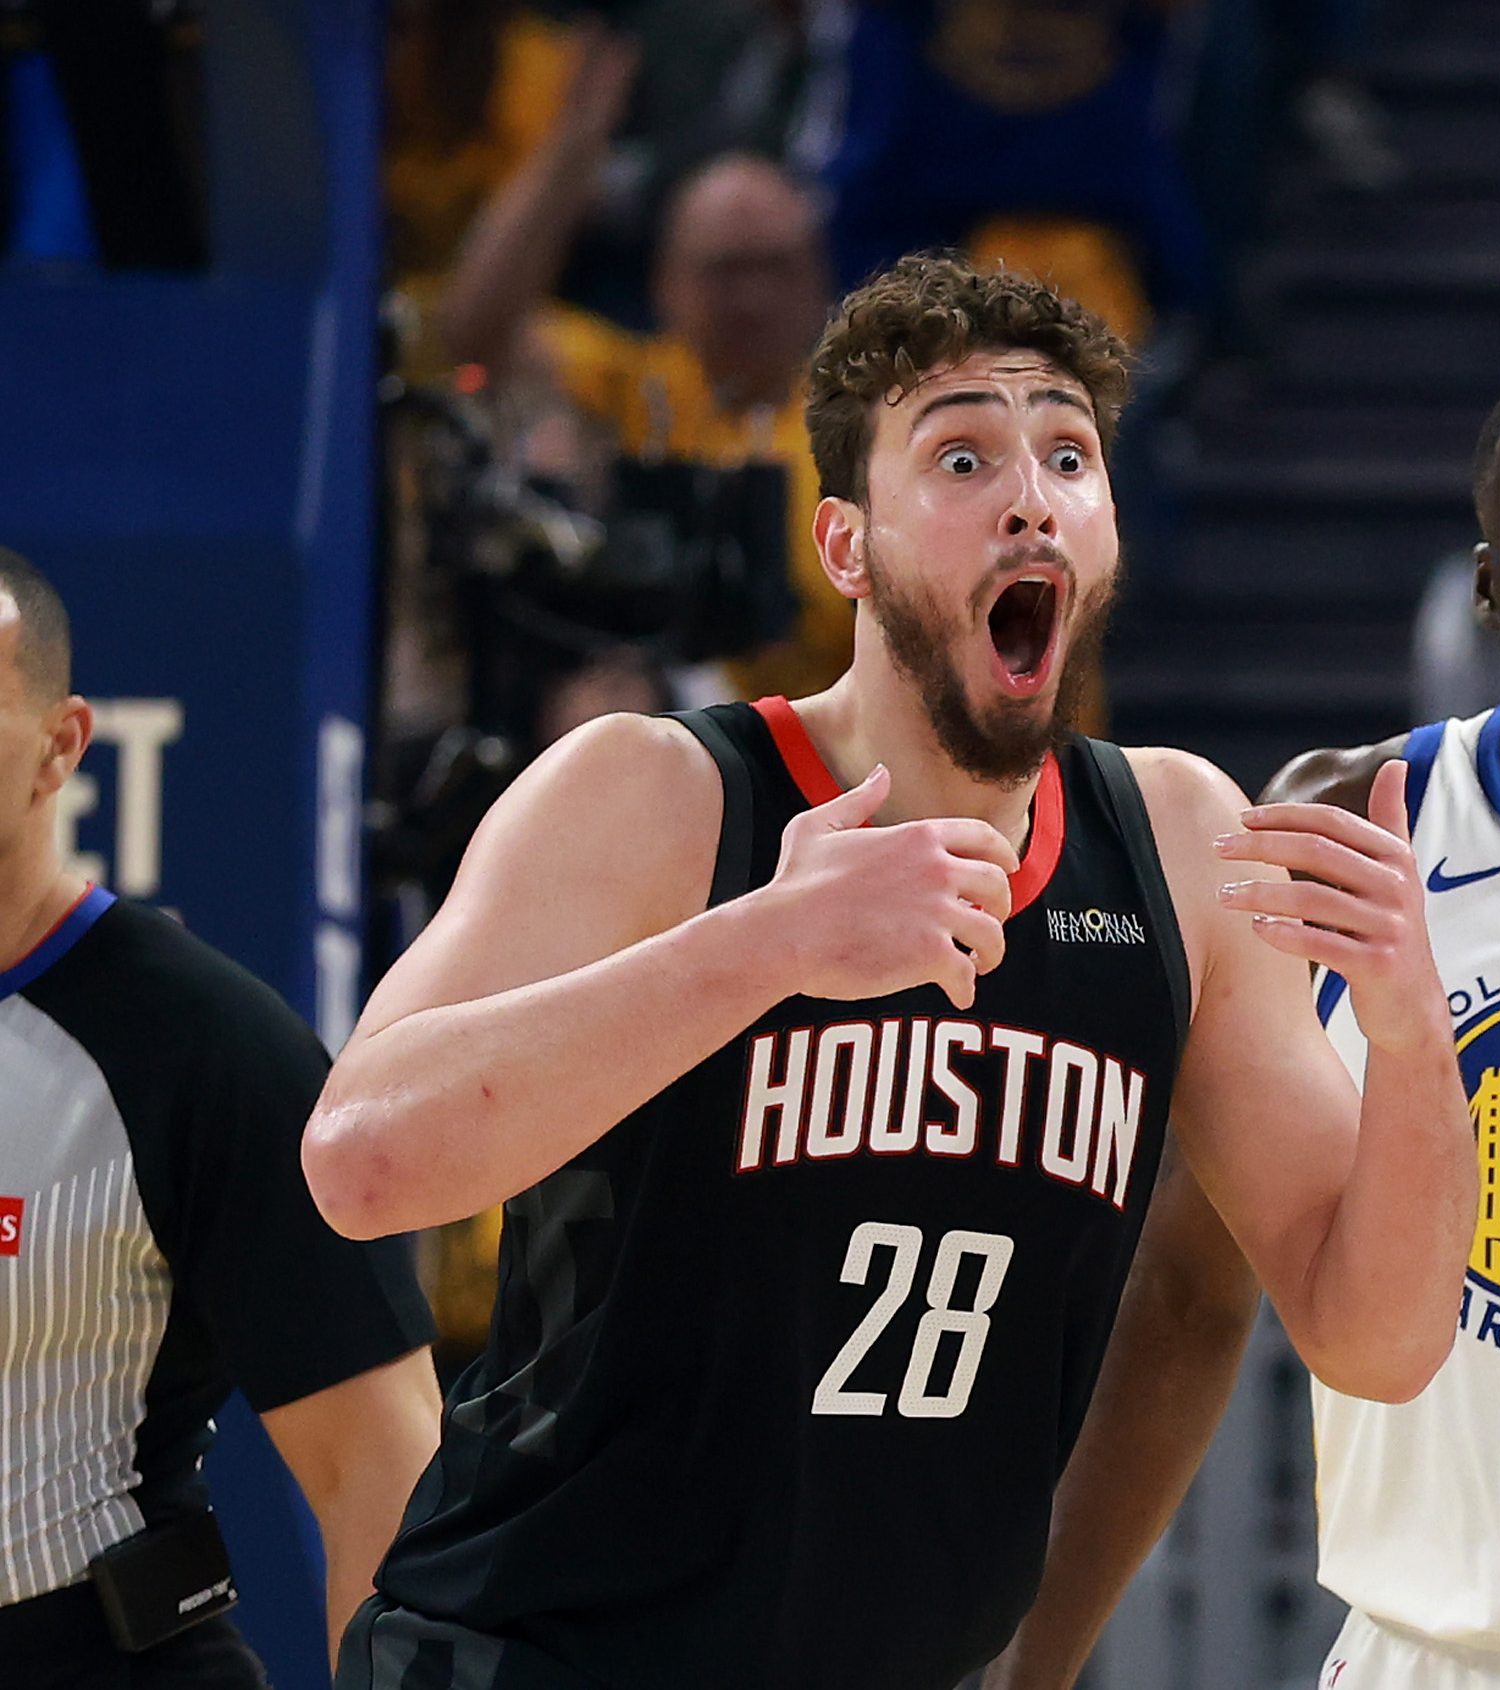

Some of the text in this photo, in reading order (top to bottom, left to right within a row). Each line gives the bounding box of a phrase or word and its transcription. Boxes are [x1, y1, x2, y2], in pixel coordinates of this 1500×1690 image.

[1046, 907, 1144, 930] MEMORIAL
[1048, 925, 1146, 944] HERMANN
[735, 1015, 1148, 1213] HOUSTON
[811, 1221, 1015, 1419] 28
